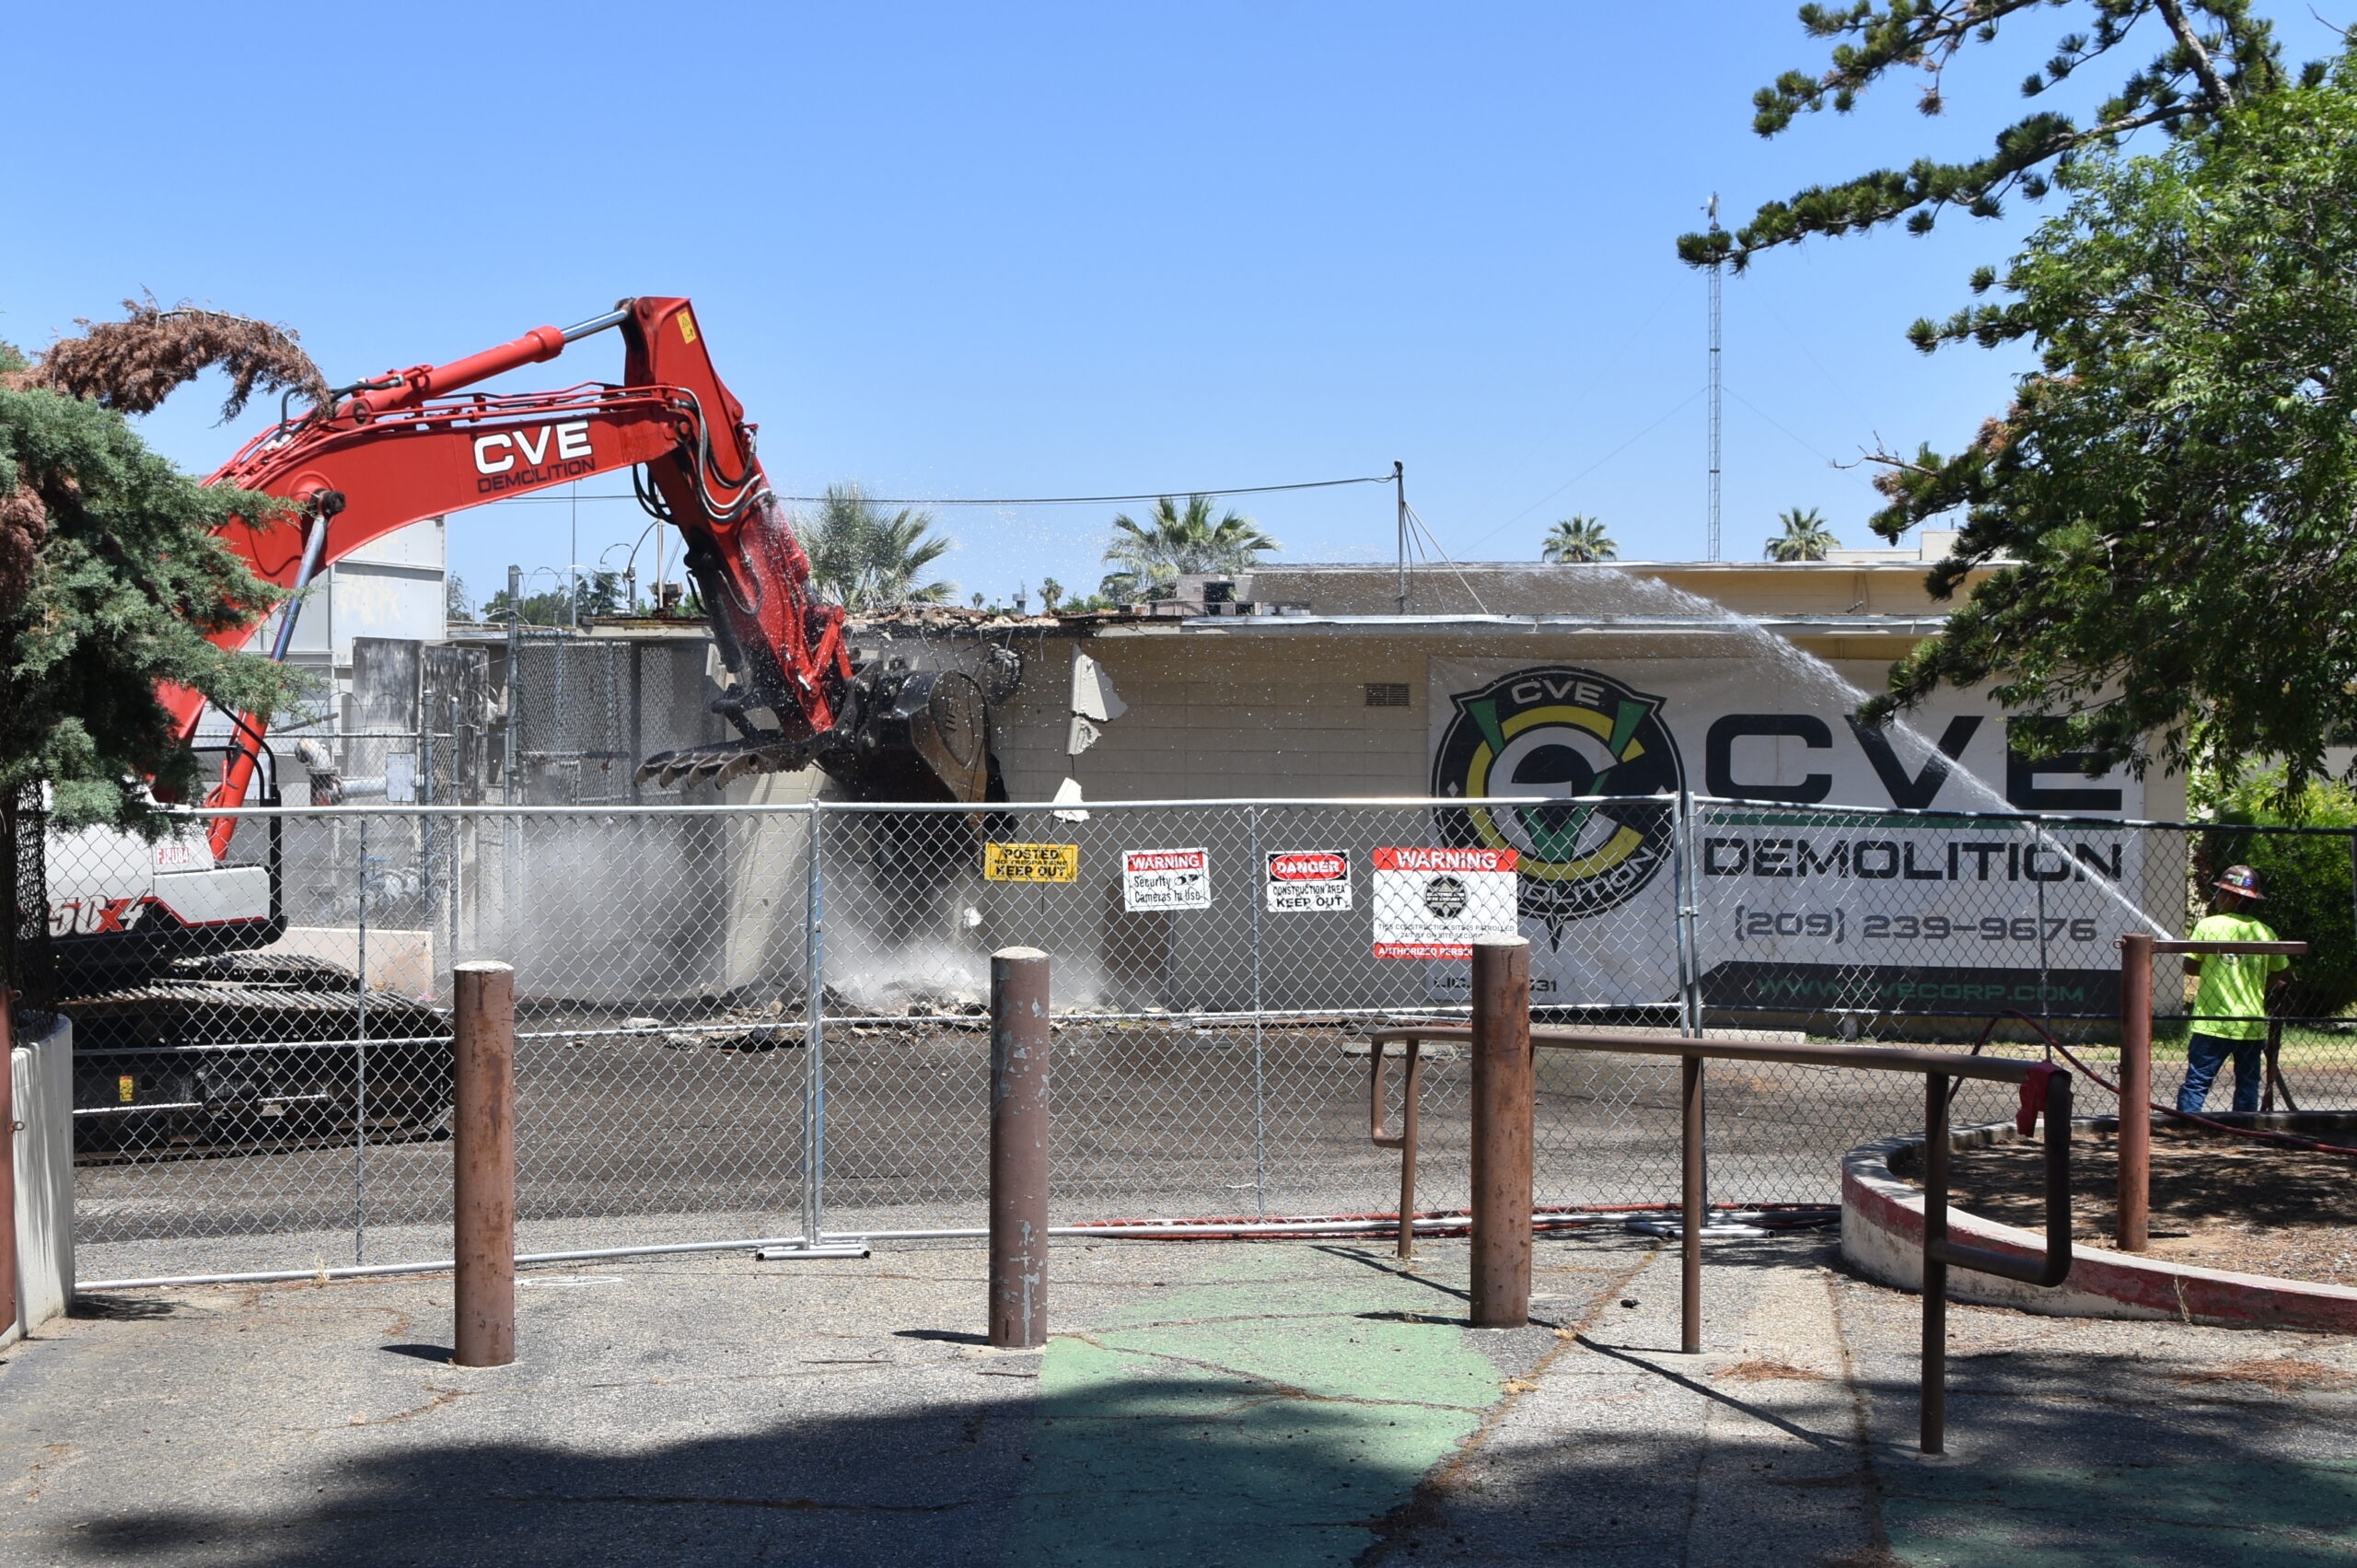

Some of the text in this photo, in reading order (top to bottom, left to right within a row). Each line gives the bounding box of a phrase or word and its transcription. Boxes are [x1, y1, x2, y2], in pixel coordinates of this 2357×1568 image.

[473, 420, 592, 474] CVE
[477, 458, 596, 494] DEMOLITION
[1511, 679, 1604, 706] CVE
[1706, 714, 2122, 811] CVE
[1004, 849, 1059, 860] POSTED
[1132, 854, 1200, 869] WARNING
[1396, 851, 1498, 869] WARNING
[1703, 838, 2122, 883] DEMOLITION
[996, 865, 1065, 877] KEEP OUT
[1276, 861, 1340, 873] DANGER
[1133, 876, 1171, 889] Security
[1134, 889, 1201, 903] Cameras In Use
[1273, 884, 1345, 896] CONSTRUCTION AREA
[1276, 896, 1342, 908] KEEP OUT
[1734, 905, 2097, 944] (209) 239-9676
[1378, 947, 1437, 956] AUTHORIZED
[1434, 977, 1470, 988] LIC.
[1754, 977, 2084, 1003] WWW.CVECORP.COM
